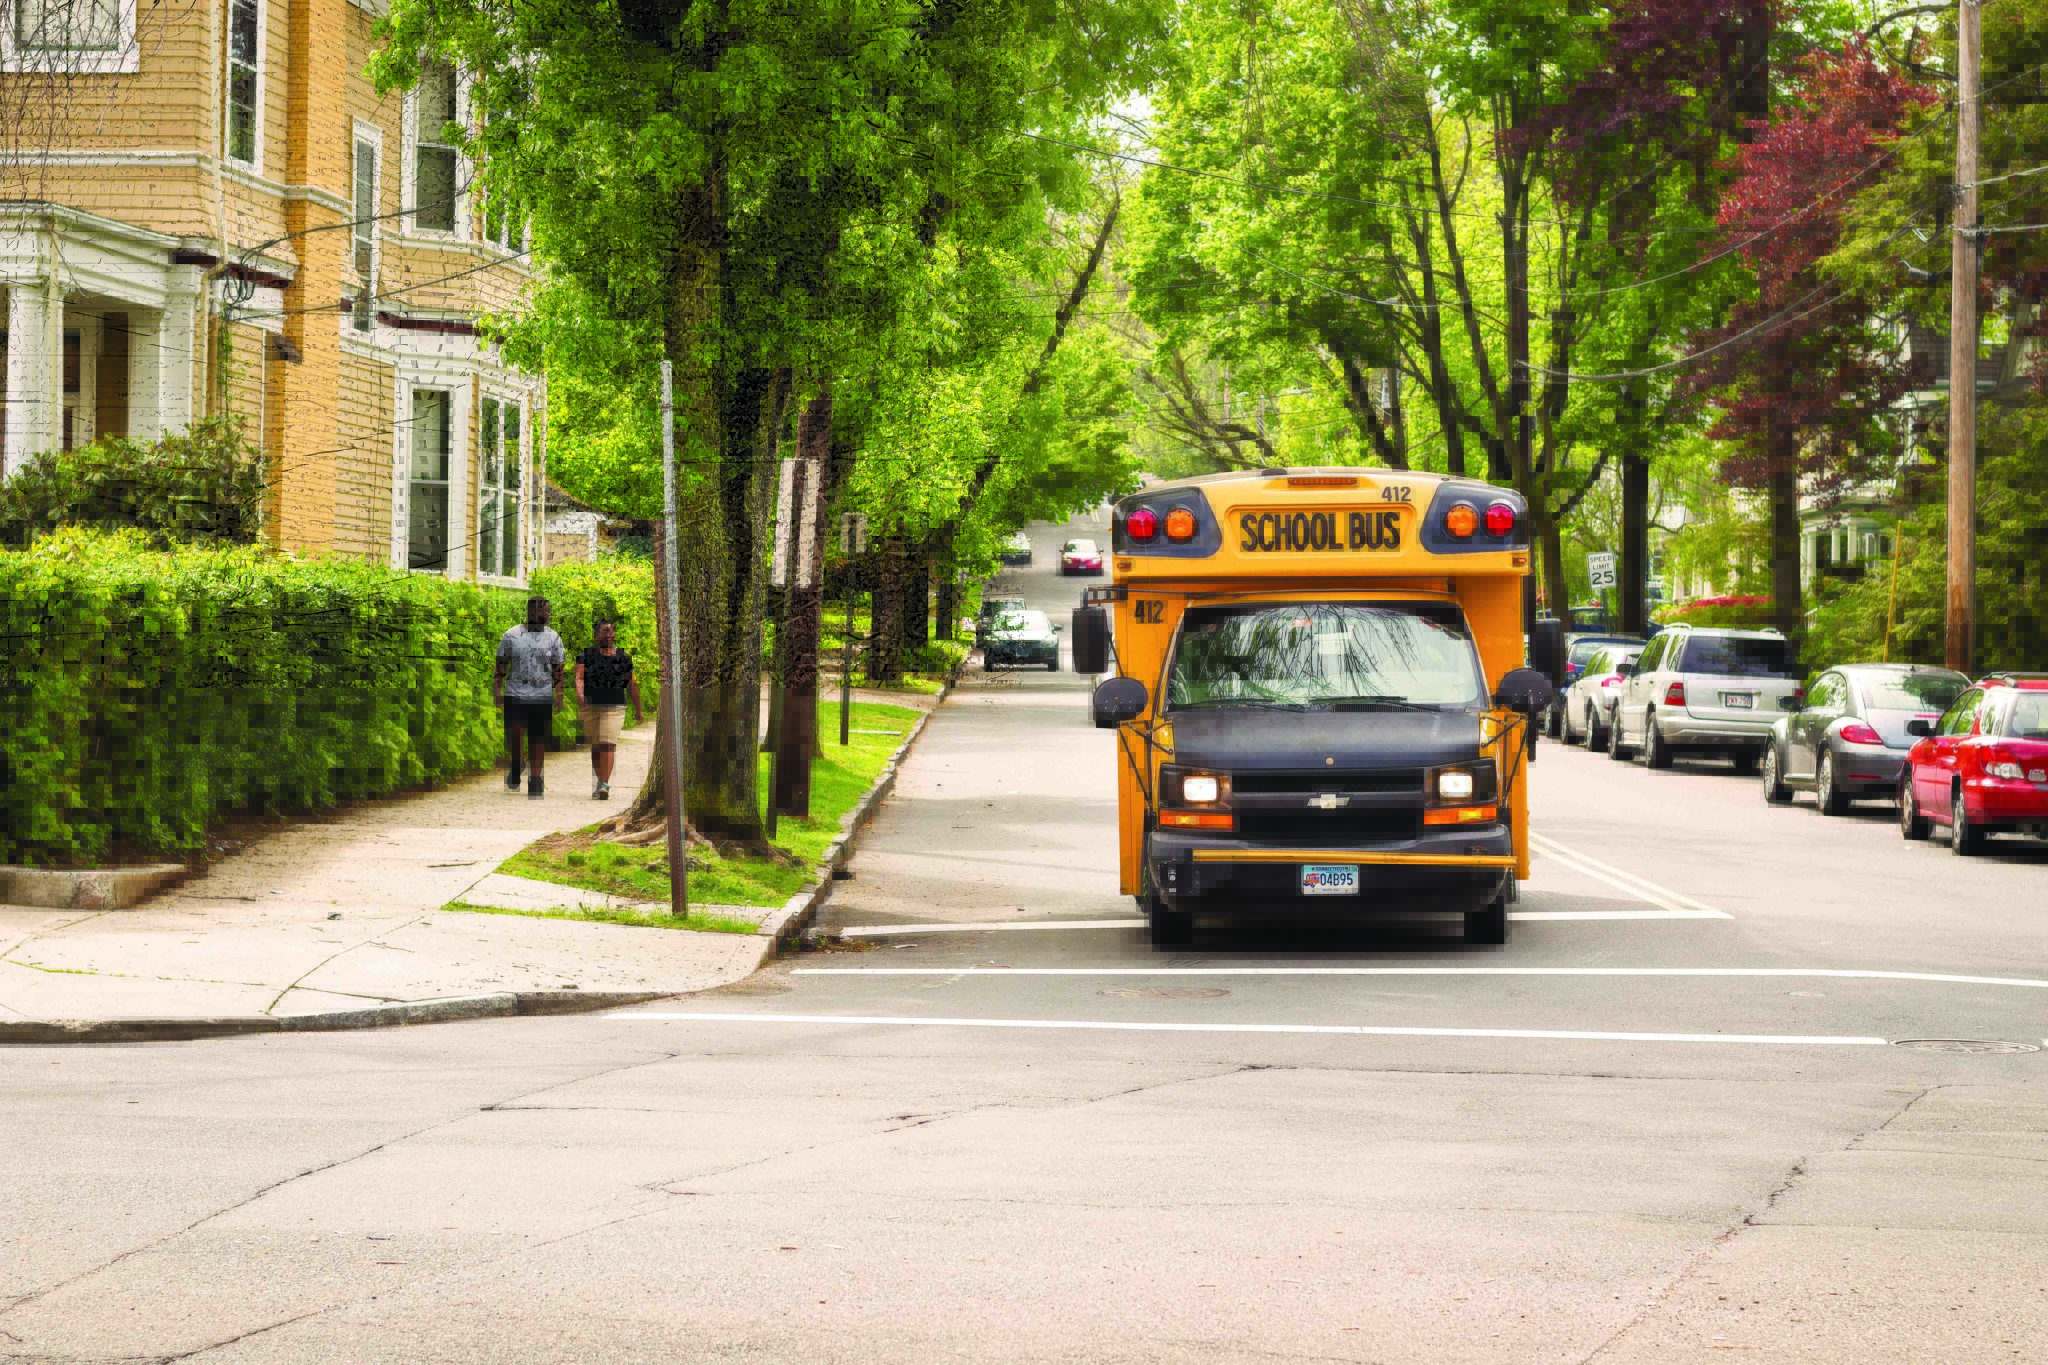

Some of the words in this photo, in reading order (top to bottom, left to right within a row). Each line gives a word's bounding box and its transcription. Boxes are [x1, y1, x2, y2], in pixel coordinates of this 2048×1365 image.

[1381, 486, 1411, 502] 412
[1241, 512, 1344, 551] SCHOOL
[1349, 512, 1401, 550] BUS
[1592, 570, 1614, 585] 25
[1134, 600, 1164, 624] 412
[1320, 873, 1353, 886] 04B95
